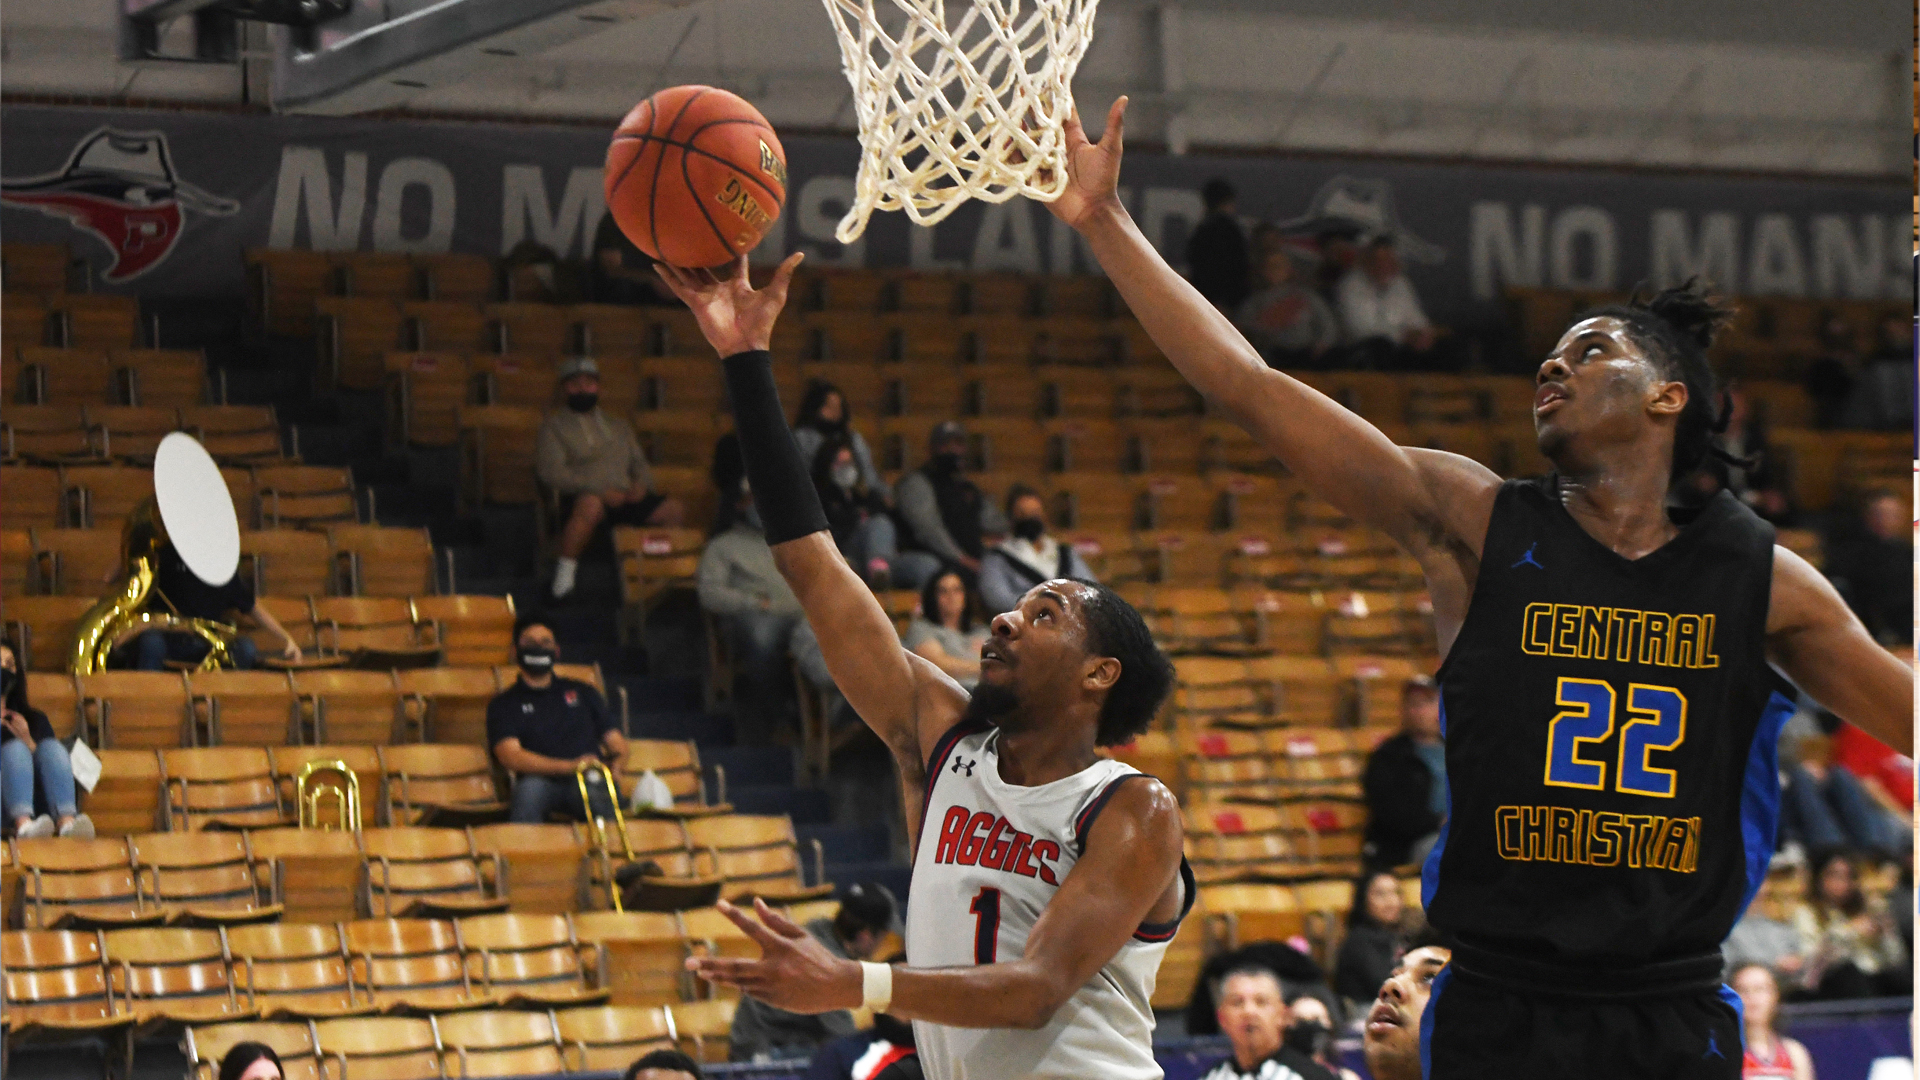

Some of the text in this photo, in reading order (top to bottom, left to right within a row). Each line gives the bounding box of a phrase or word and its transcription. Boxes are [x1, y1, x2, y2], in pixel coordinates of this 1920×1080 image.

[268, 145, 456, 252] NO
[1469, 202, 1618, 296] NO
[1521, 602, 1720, 668] CENTRAL
[1544, 676, 1688, 798] 22
[969, 886, 1001, 964] 1
